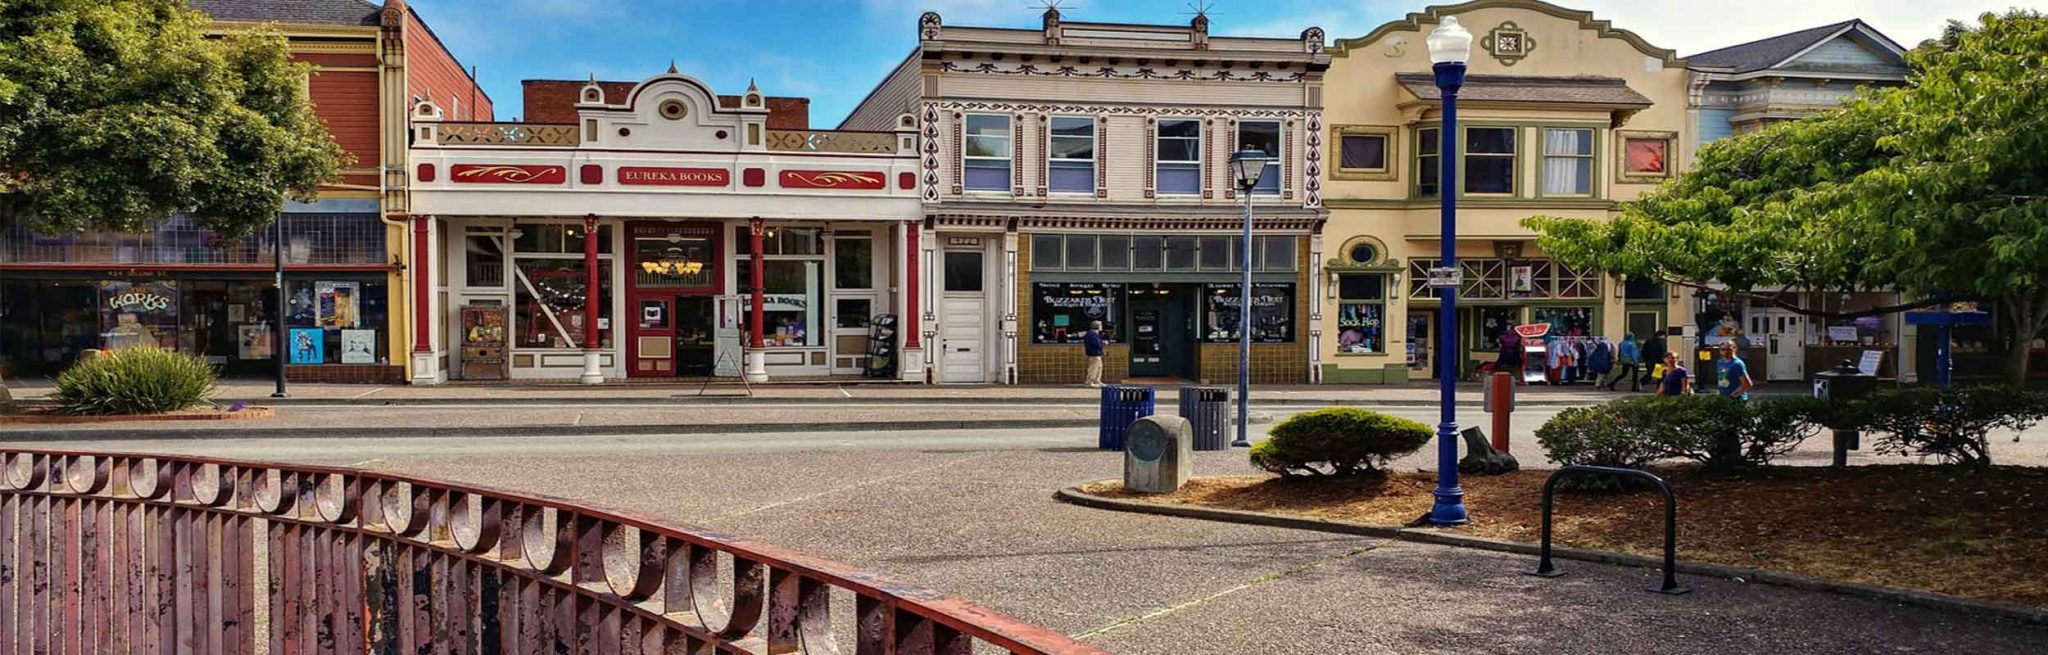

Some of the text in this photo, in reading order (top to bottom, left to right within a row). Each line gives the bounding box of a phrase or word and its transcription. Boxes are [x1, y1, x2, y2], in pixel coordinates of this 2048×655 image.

[625, 171, 722, 181] EUREKA BOOKS
[109, 293, 170, 310] WORKS
[777, 297, 807, 309] BOOKS
